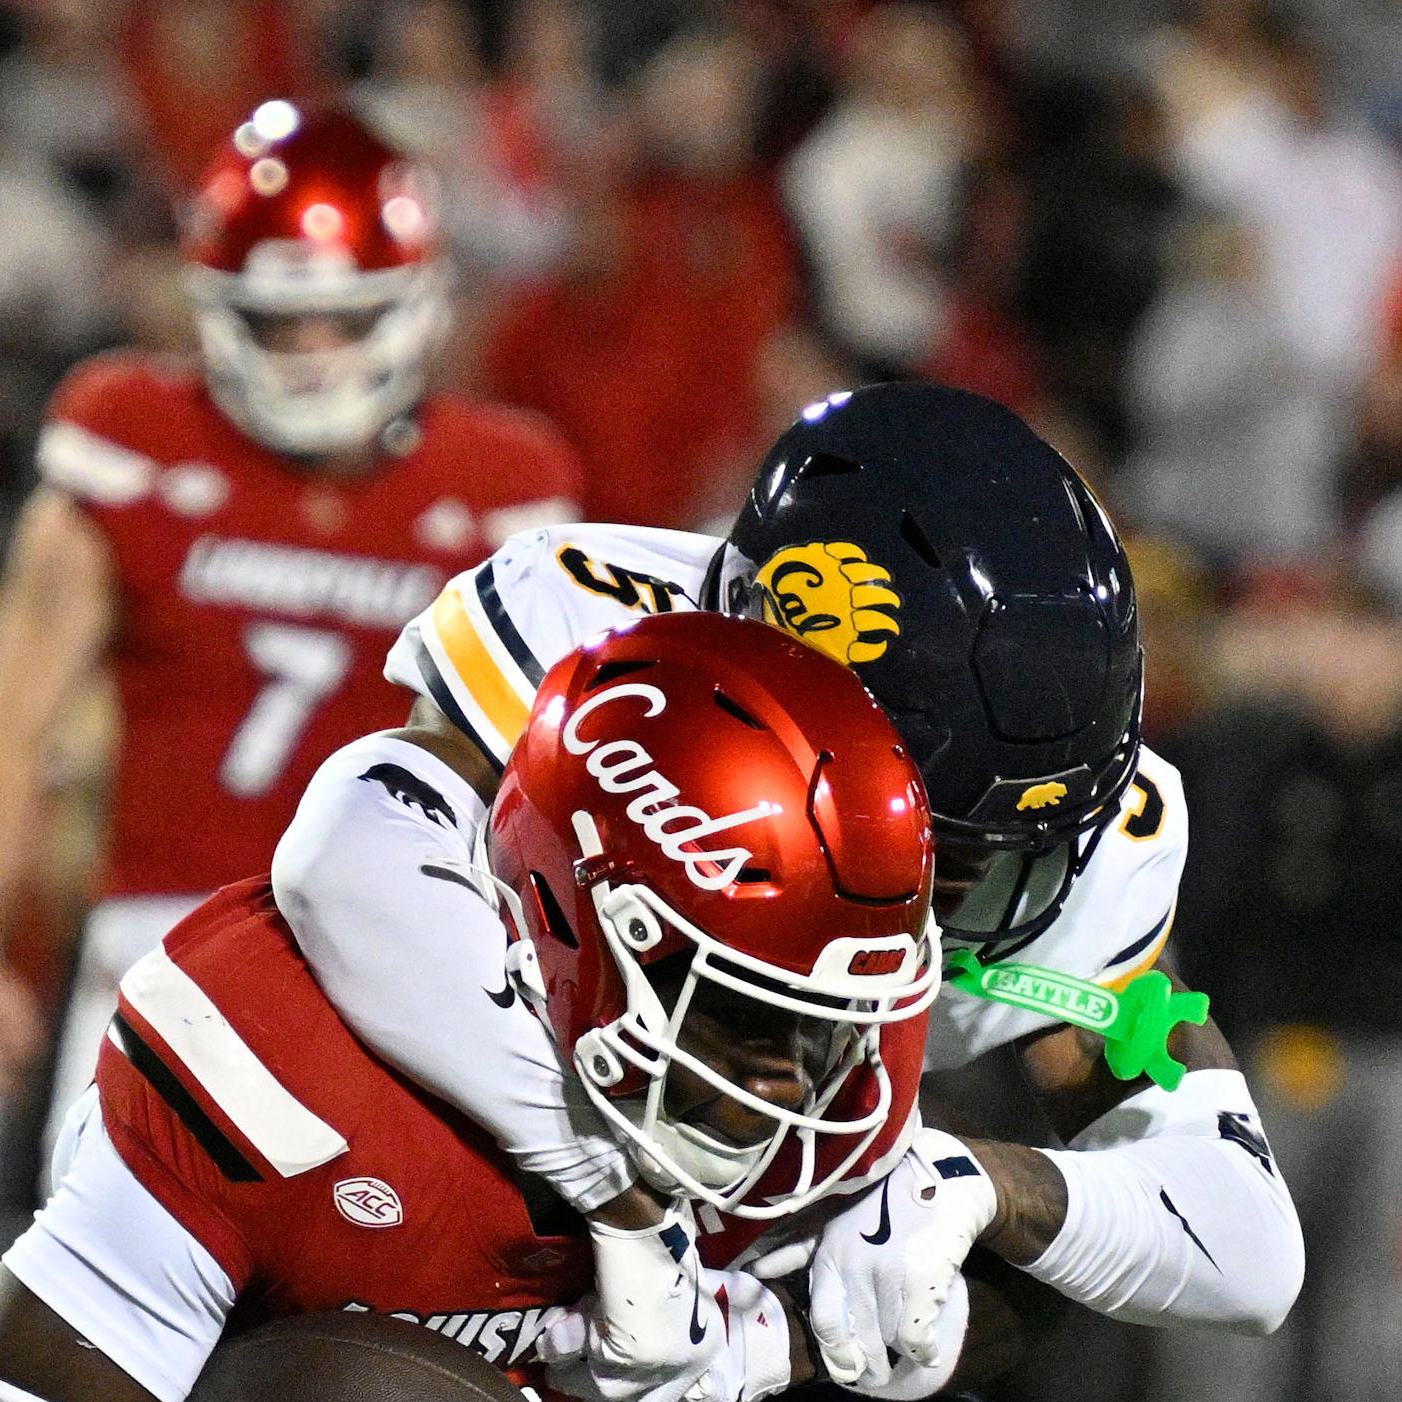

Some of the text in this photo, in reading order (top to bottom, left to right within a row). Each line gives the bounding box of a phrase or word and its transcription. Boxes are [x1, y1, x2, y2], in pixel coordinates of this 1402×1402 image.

[771, 561, 841, 636] Cal
[215, 620, 353, 799] 7
[563, 683, 784, 891] Cards
[995, 970, 1109, 1021] BATTLE
[342, 1190, 397, 1218] ACC
